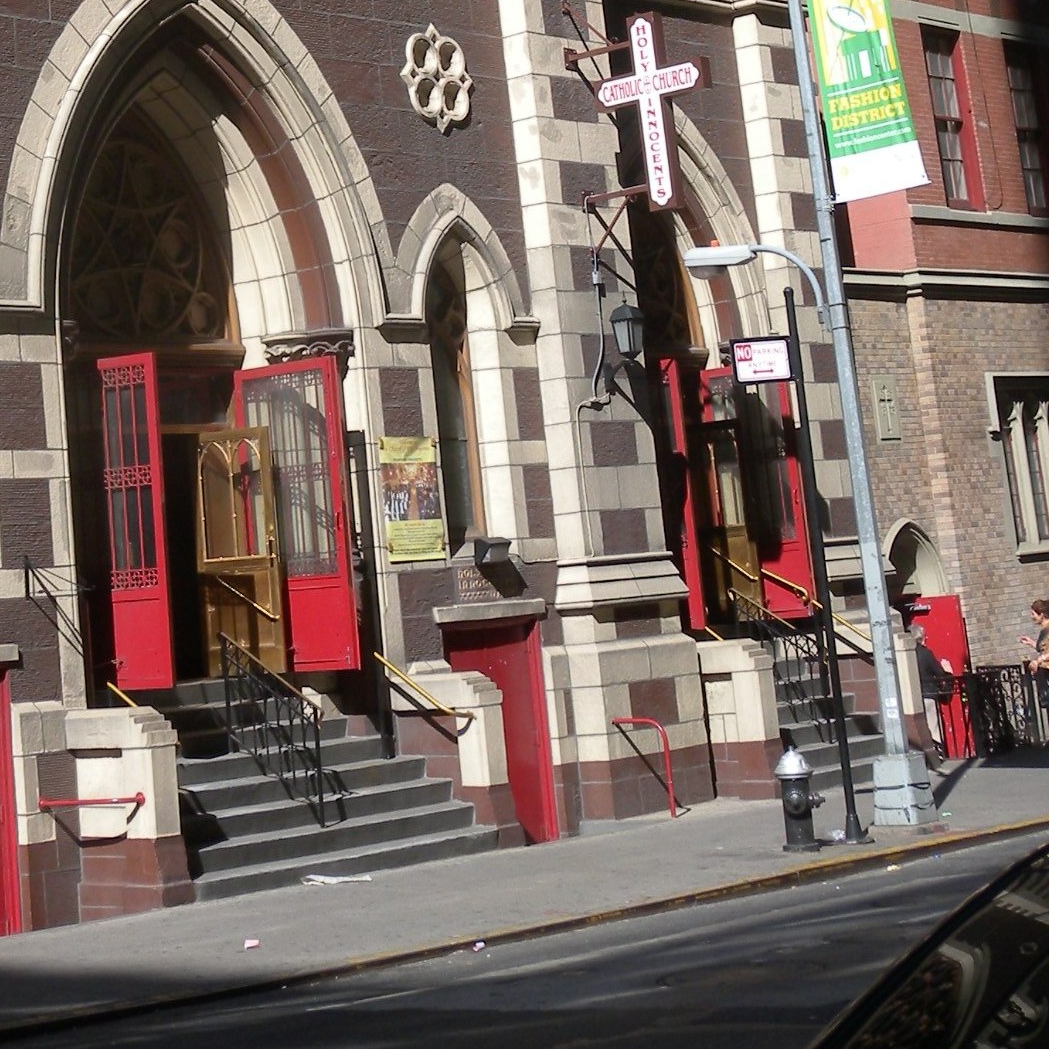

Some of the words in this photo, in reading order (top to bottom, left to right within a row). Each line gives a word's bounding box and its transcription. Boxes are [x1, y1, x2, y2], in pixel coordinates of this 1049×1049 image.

[636, 25, 649, 72] HOLY
[602, 79, 644, 103] CATHOLIC
[652, 67, 692, 91] CHURCH
[828, 83, 902, 113] FASHION
[831, 101, 905, 131] DISTRICT
[648, 98, 667, 198] INNOCENTS
[736, 346, 751, 360] NO
[753, 347, 784, 355] PARKING
